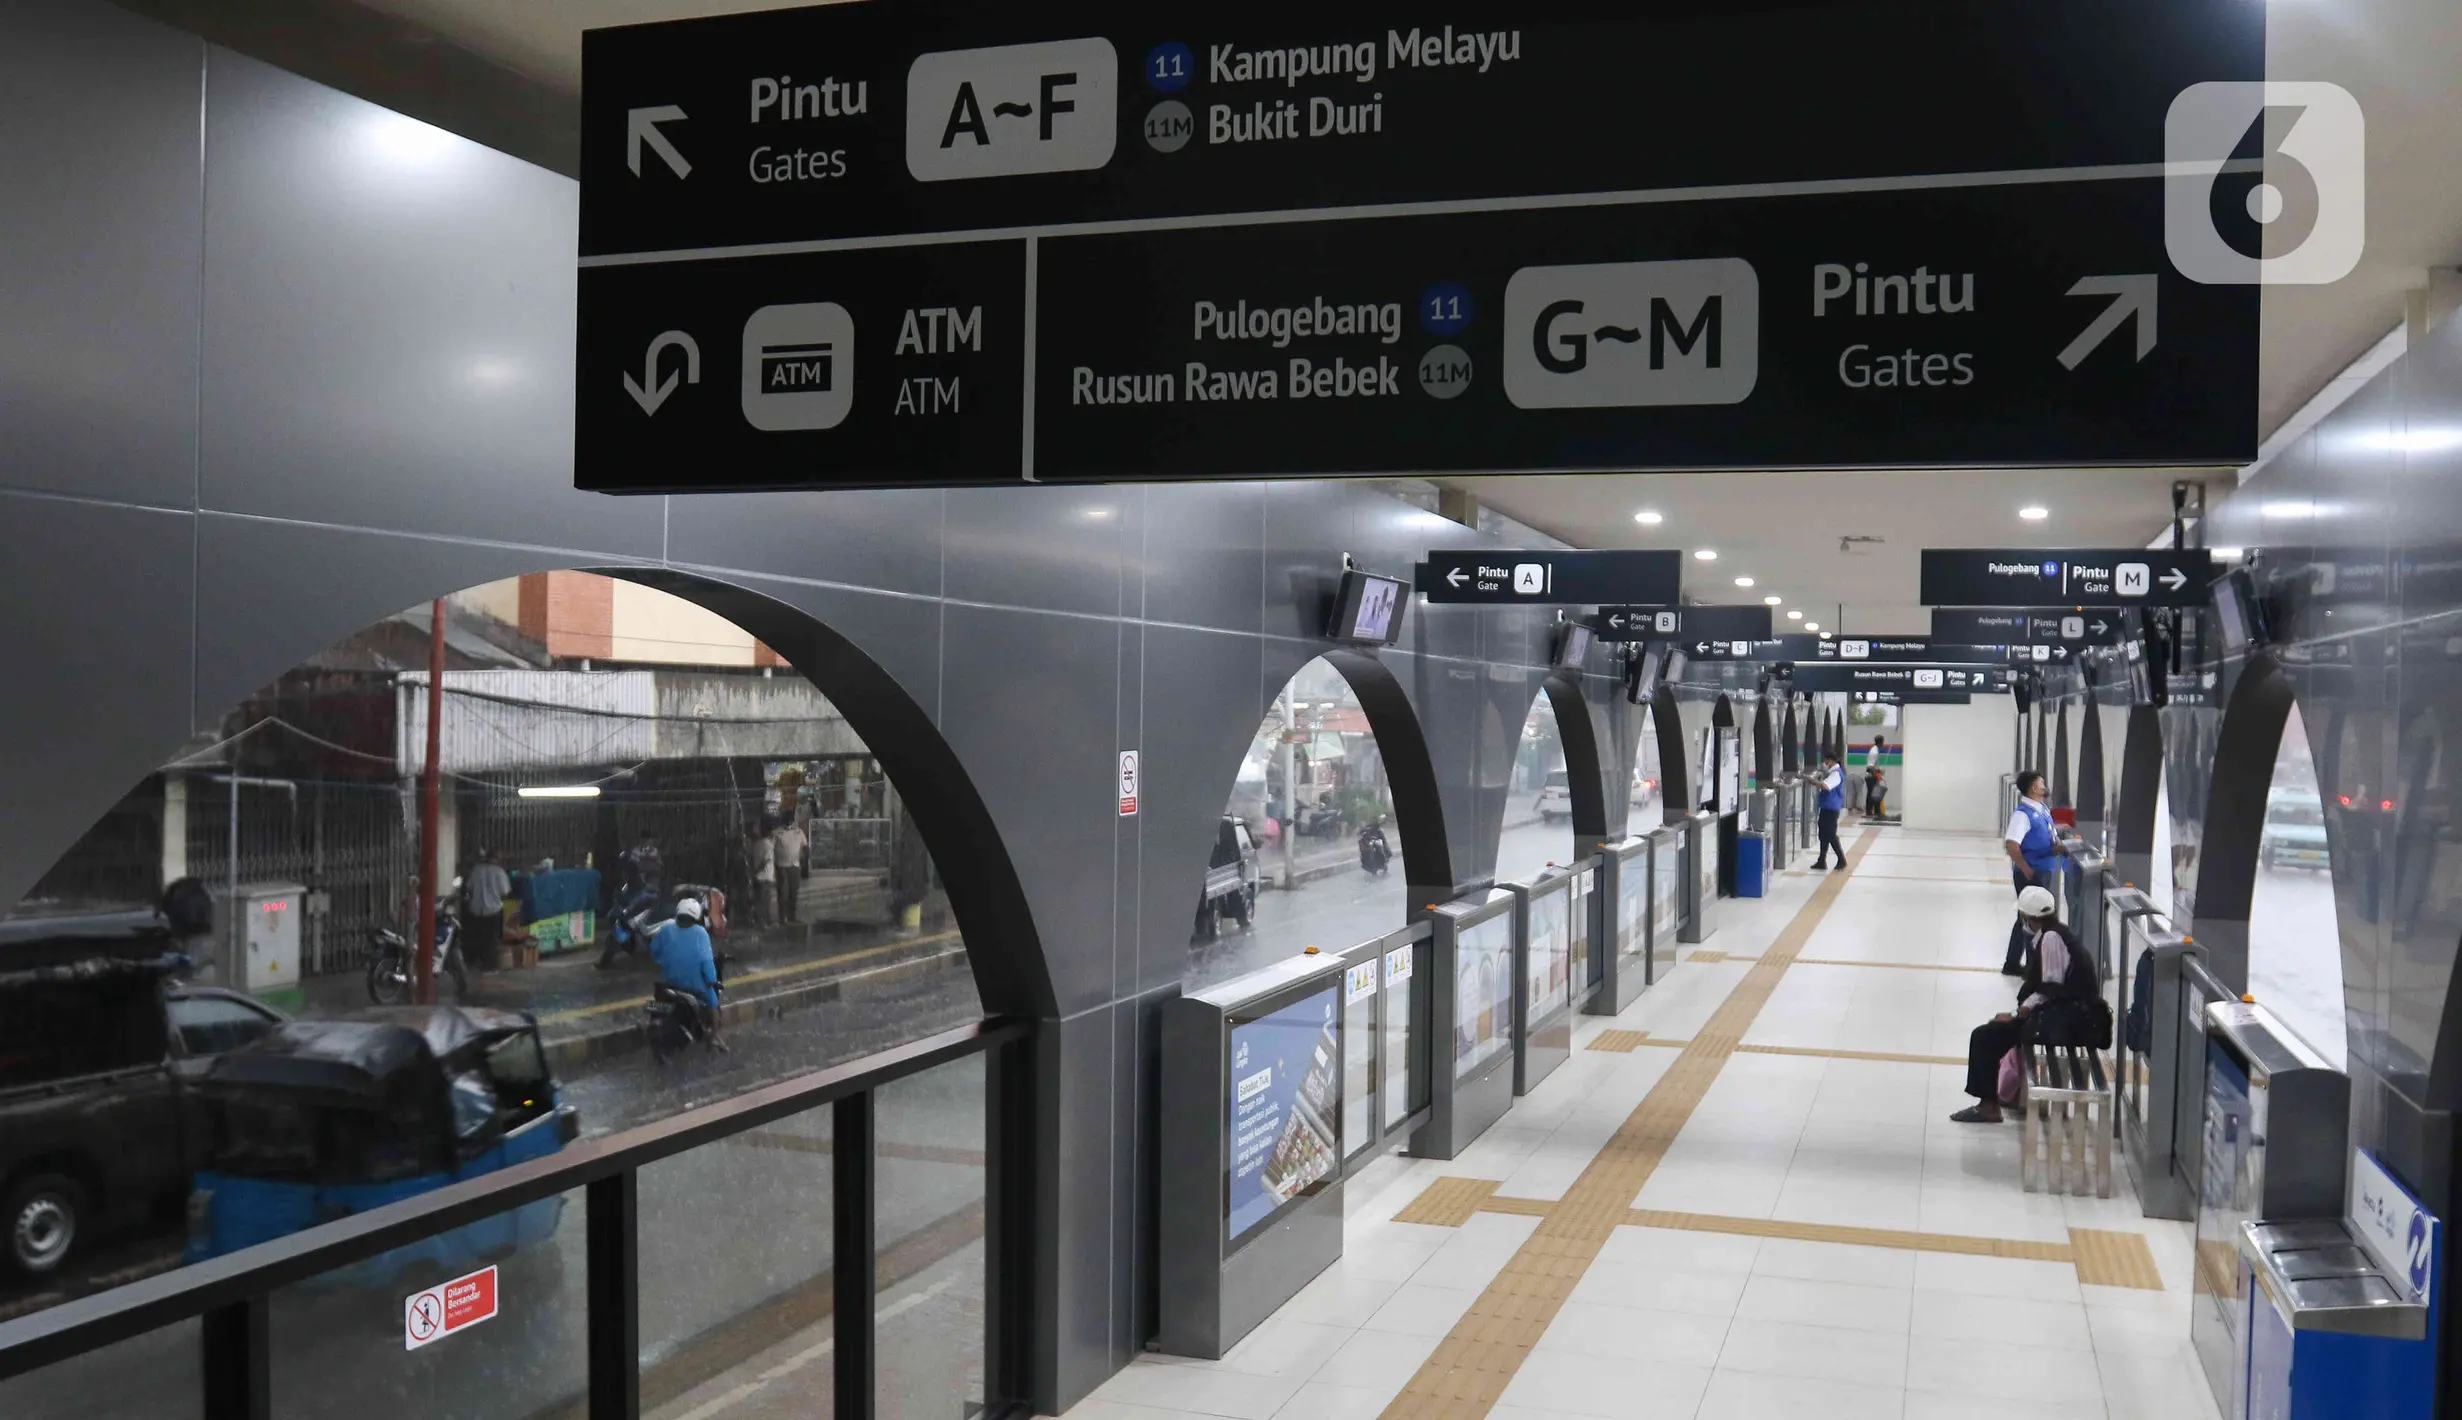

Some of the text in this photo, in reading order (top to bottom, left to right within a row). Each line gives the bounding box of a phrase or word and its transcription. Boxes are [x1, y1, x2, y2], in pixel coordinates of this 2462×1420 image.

[1155, 54, 1184, 78] 11
[1210, 25, 1521, 84] Kampung Melayu
[751, 75, 867, 123] Pintu
[940, 72, 1077, 148] A~F
[1147, 115, 1193, 138] 11M
[1209, 93, 1383, 144] Bukit Duri
[749, 146, 846, 183] Gates
[1813, 262, 1975, 317] Pintu
[1430, 297, 1462, 320] 11
[894, 305, 982, 355] ATM
[1194, 296, 1401, 348] Pulogebang
[1533, 295, 1722, 374] G~M
[771, 361, 821, 386] ATM
[1420, 361, 1470, 384] 11M
[1838, 344, 1974, 388] Gates
[1073, 355, 1400, 405] Rusun Rawa Bebek
[895, 377, 960, 416] ATM
[1478, 566, 1509, 578] Pintu
[1523, 572, 1534, 585] A
[1989, 563, 2040, 575] Pulogebang
[2073, 566, 2109, 579] Pintu
[2125, 572, 2141, 586] M
[1478, 580, 1499, 590] Gate
[2084, 582, 2109, 592] Gate
[1630, 613, 1652, 622] Pintu
[1662, 619, 1669, 627] B
[2034, 618, 2058, 627] Pintu
[2068, 622, 2077, 632] L
[1737, 643, 1743, 651] C
[1947, 670, 1966, 679] Pintu
[447, 1282, 477, 1298] Dilarang
[447, 1290, 481, 1309] Bersandar
